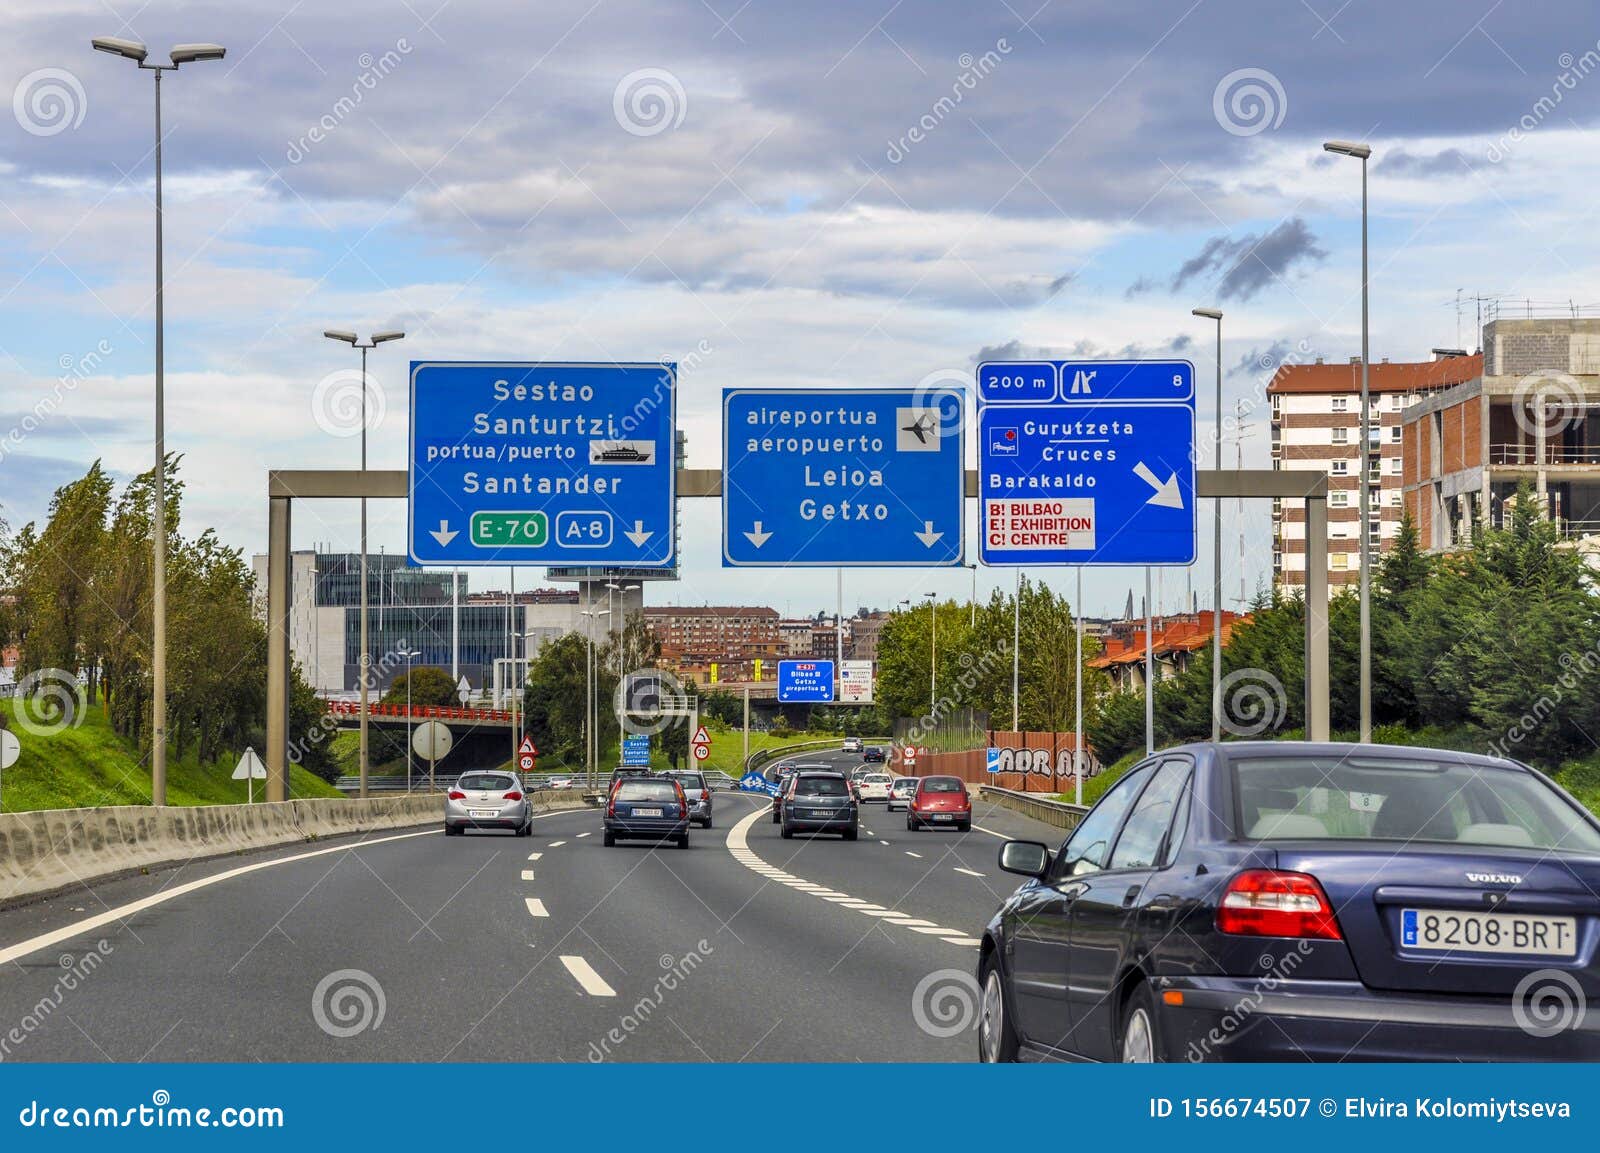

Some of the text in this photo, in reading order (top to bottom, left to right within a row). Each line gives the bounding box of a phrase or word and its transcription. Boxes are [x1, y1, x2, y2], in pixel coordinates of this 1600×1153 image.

[989, 376, 1046, 389] 200 m
[1173, 375, 1183, 387] 8
[493, 380, 594, 401] Sestao
[473, 412, 616, 435] Santurtzi
[746, 407, 877, 428] aireportua
[1023, 421, 1134, 436] Gurutzeta
[746, 435, 884, 455] aeropuerto
[427, 444, 576, 463] portua/puerto
[1042, 447, 1117, 461] Cruces
[463, 472, 622, 494] Santander
[804, 465, 884, 487] Leioa
[989, 473, 1097, 488] Barakaldo
[799, 499, 889, 521] Getxo
[1010, 503, 1063, 516] BILBAO
[479, 521, 539, 538] E-70
[566, 521, 604, 538] A-8
[1010, 517, 1091, 531] EXHIBITION
[1010, 532, 1068, 546] CENTRE
[523, 758, 532, 766] 70
[1466, 872, 1522, 884] VOLVO
